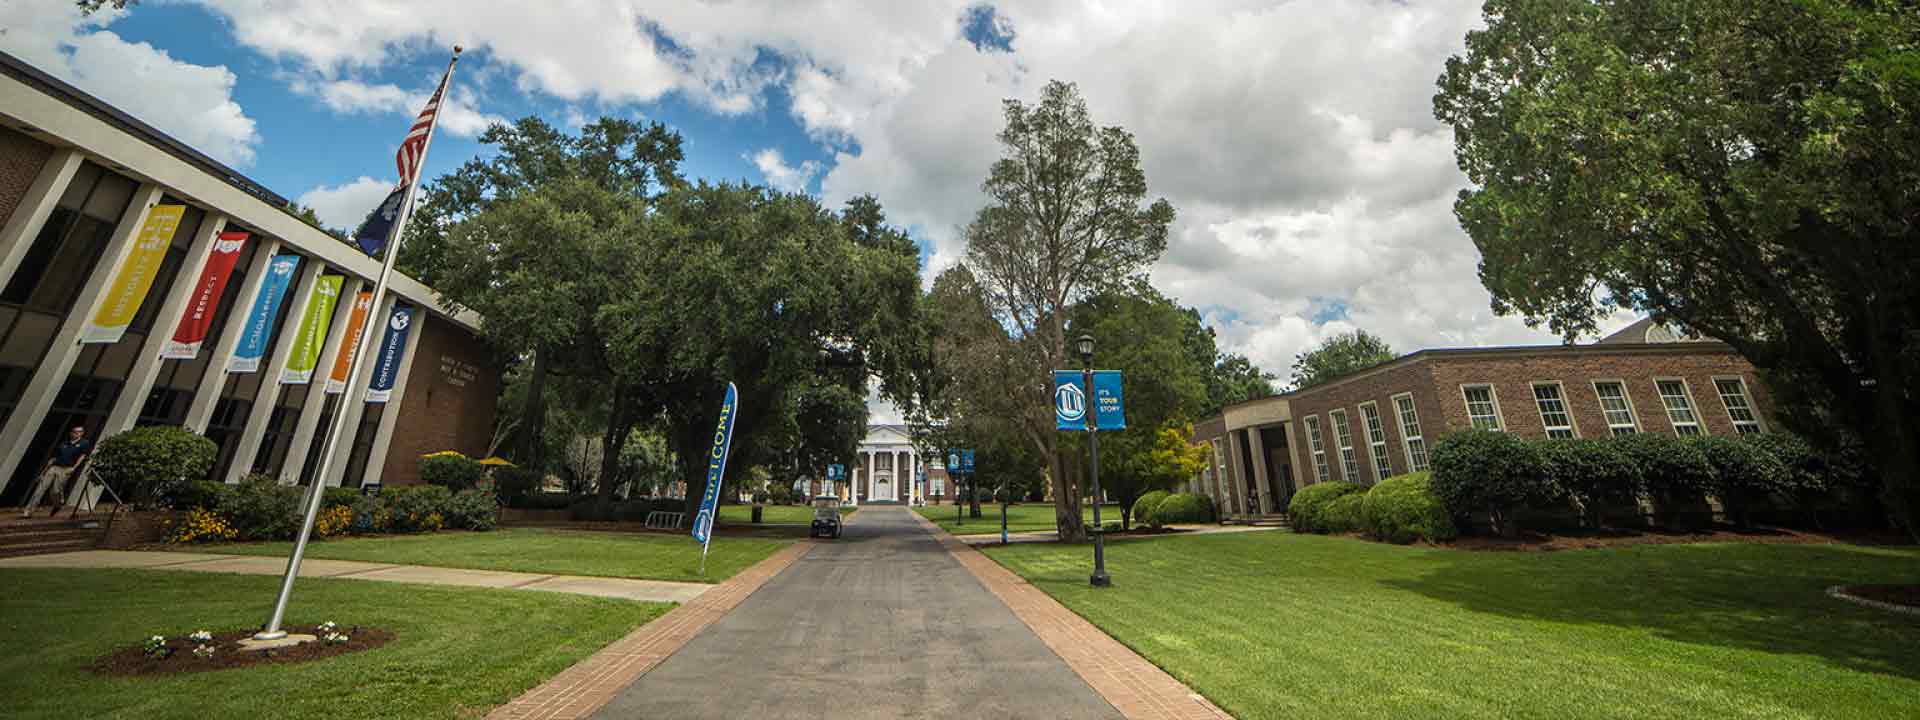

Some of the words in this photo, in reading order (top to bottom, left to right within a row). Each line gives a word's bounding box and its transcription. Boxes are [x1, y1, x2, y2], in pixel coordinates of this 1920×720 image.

[192, 275, 217, 320] RESPECT
[378, 331, 400, 389] CONTRIBUTION
[706, 403, 731, 501] WELCOME
